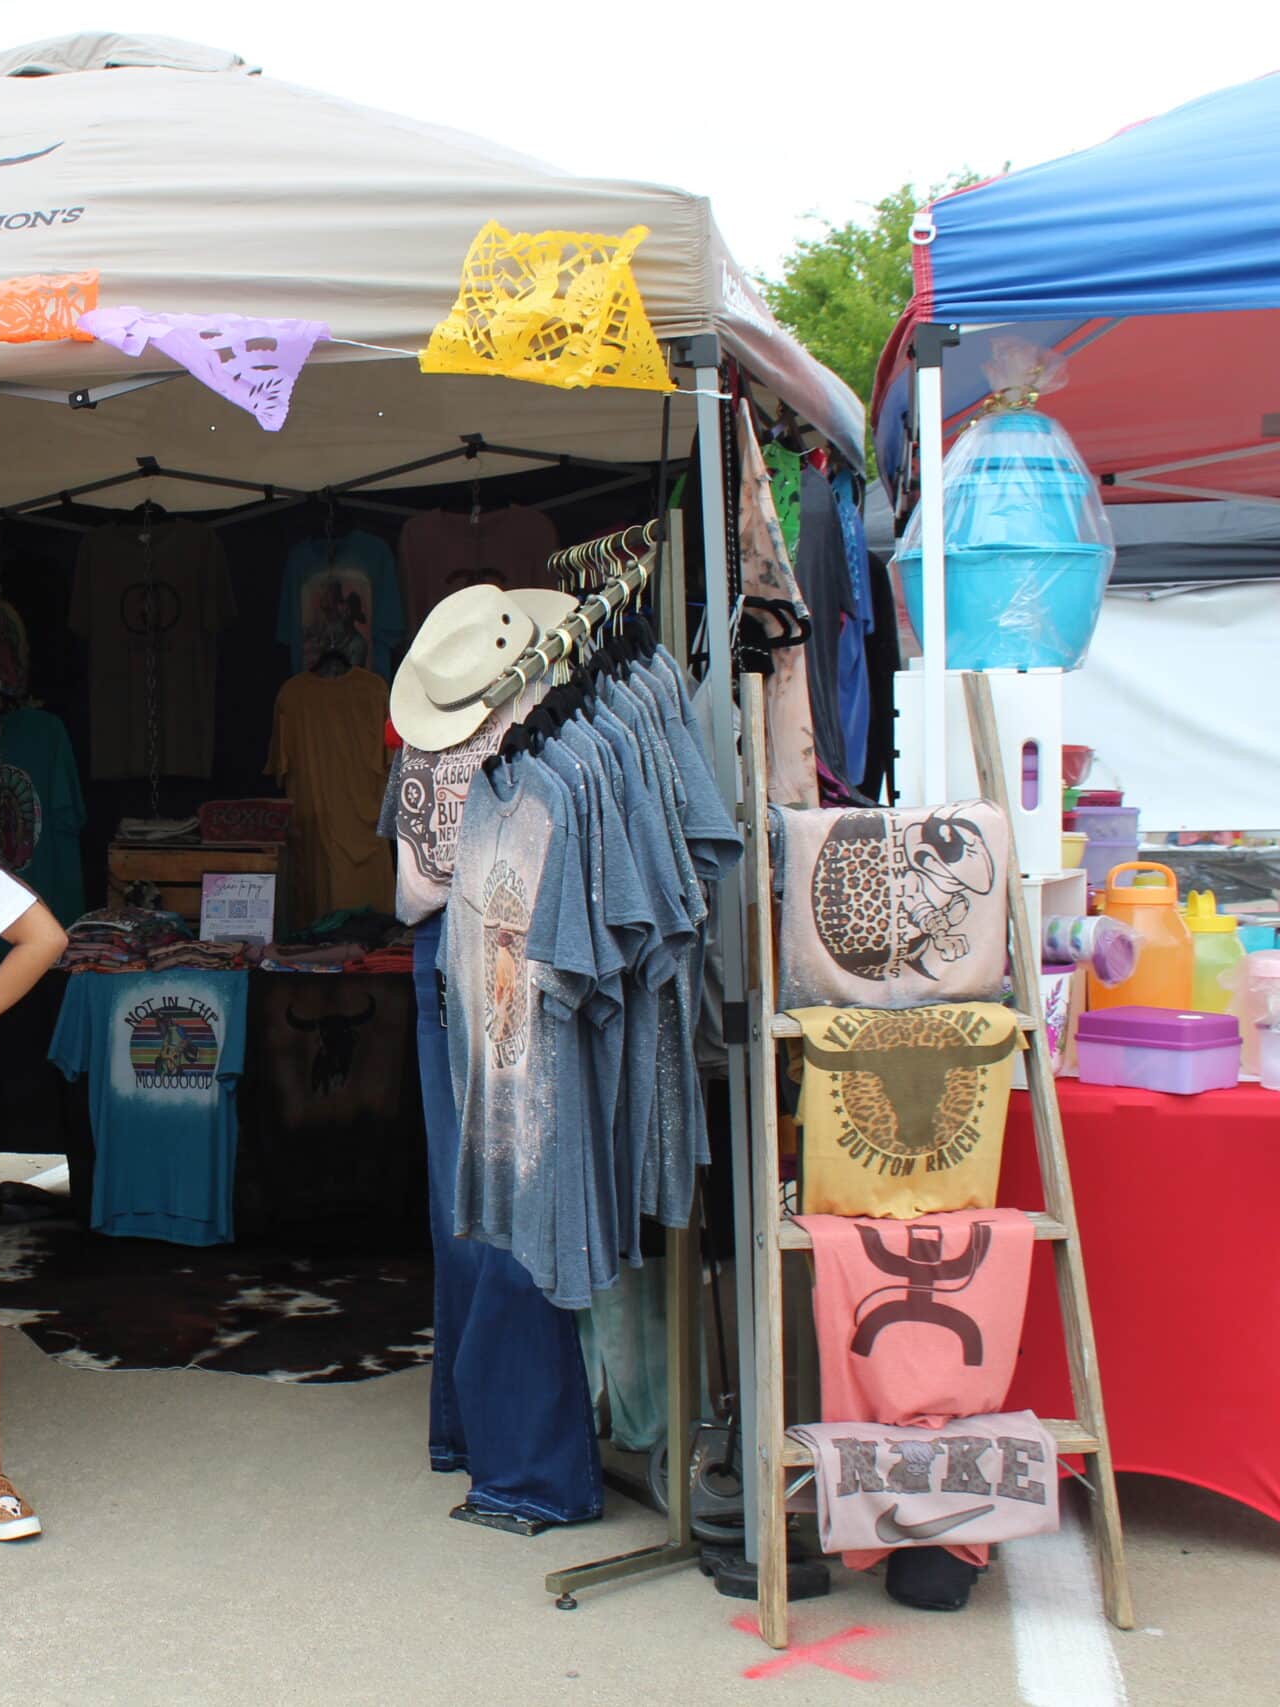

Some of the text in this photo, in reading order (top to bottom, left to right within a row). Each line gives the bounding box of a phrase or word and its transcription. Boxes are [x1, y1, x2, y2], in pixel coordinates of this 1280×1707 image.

[124, 997, 155, 1028] NOT
[161, 996, 179, 1008] IN
[836, 1123, 981, 1176] DUTTON RANCH
